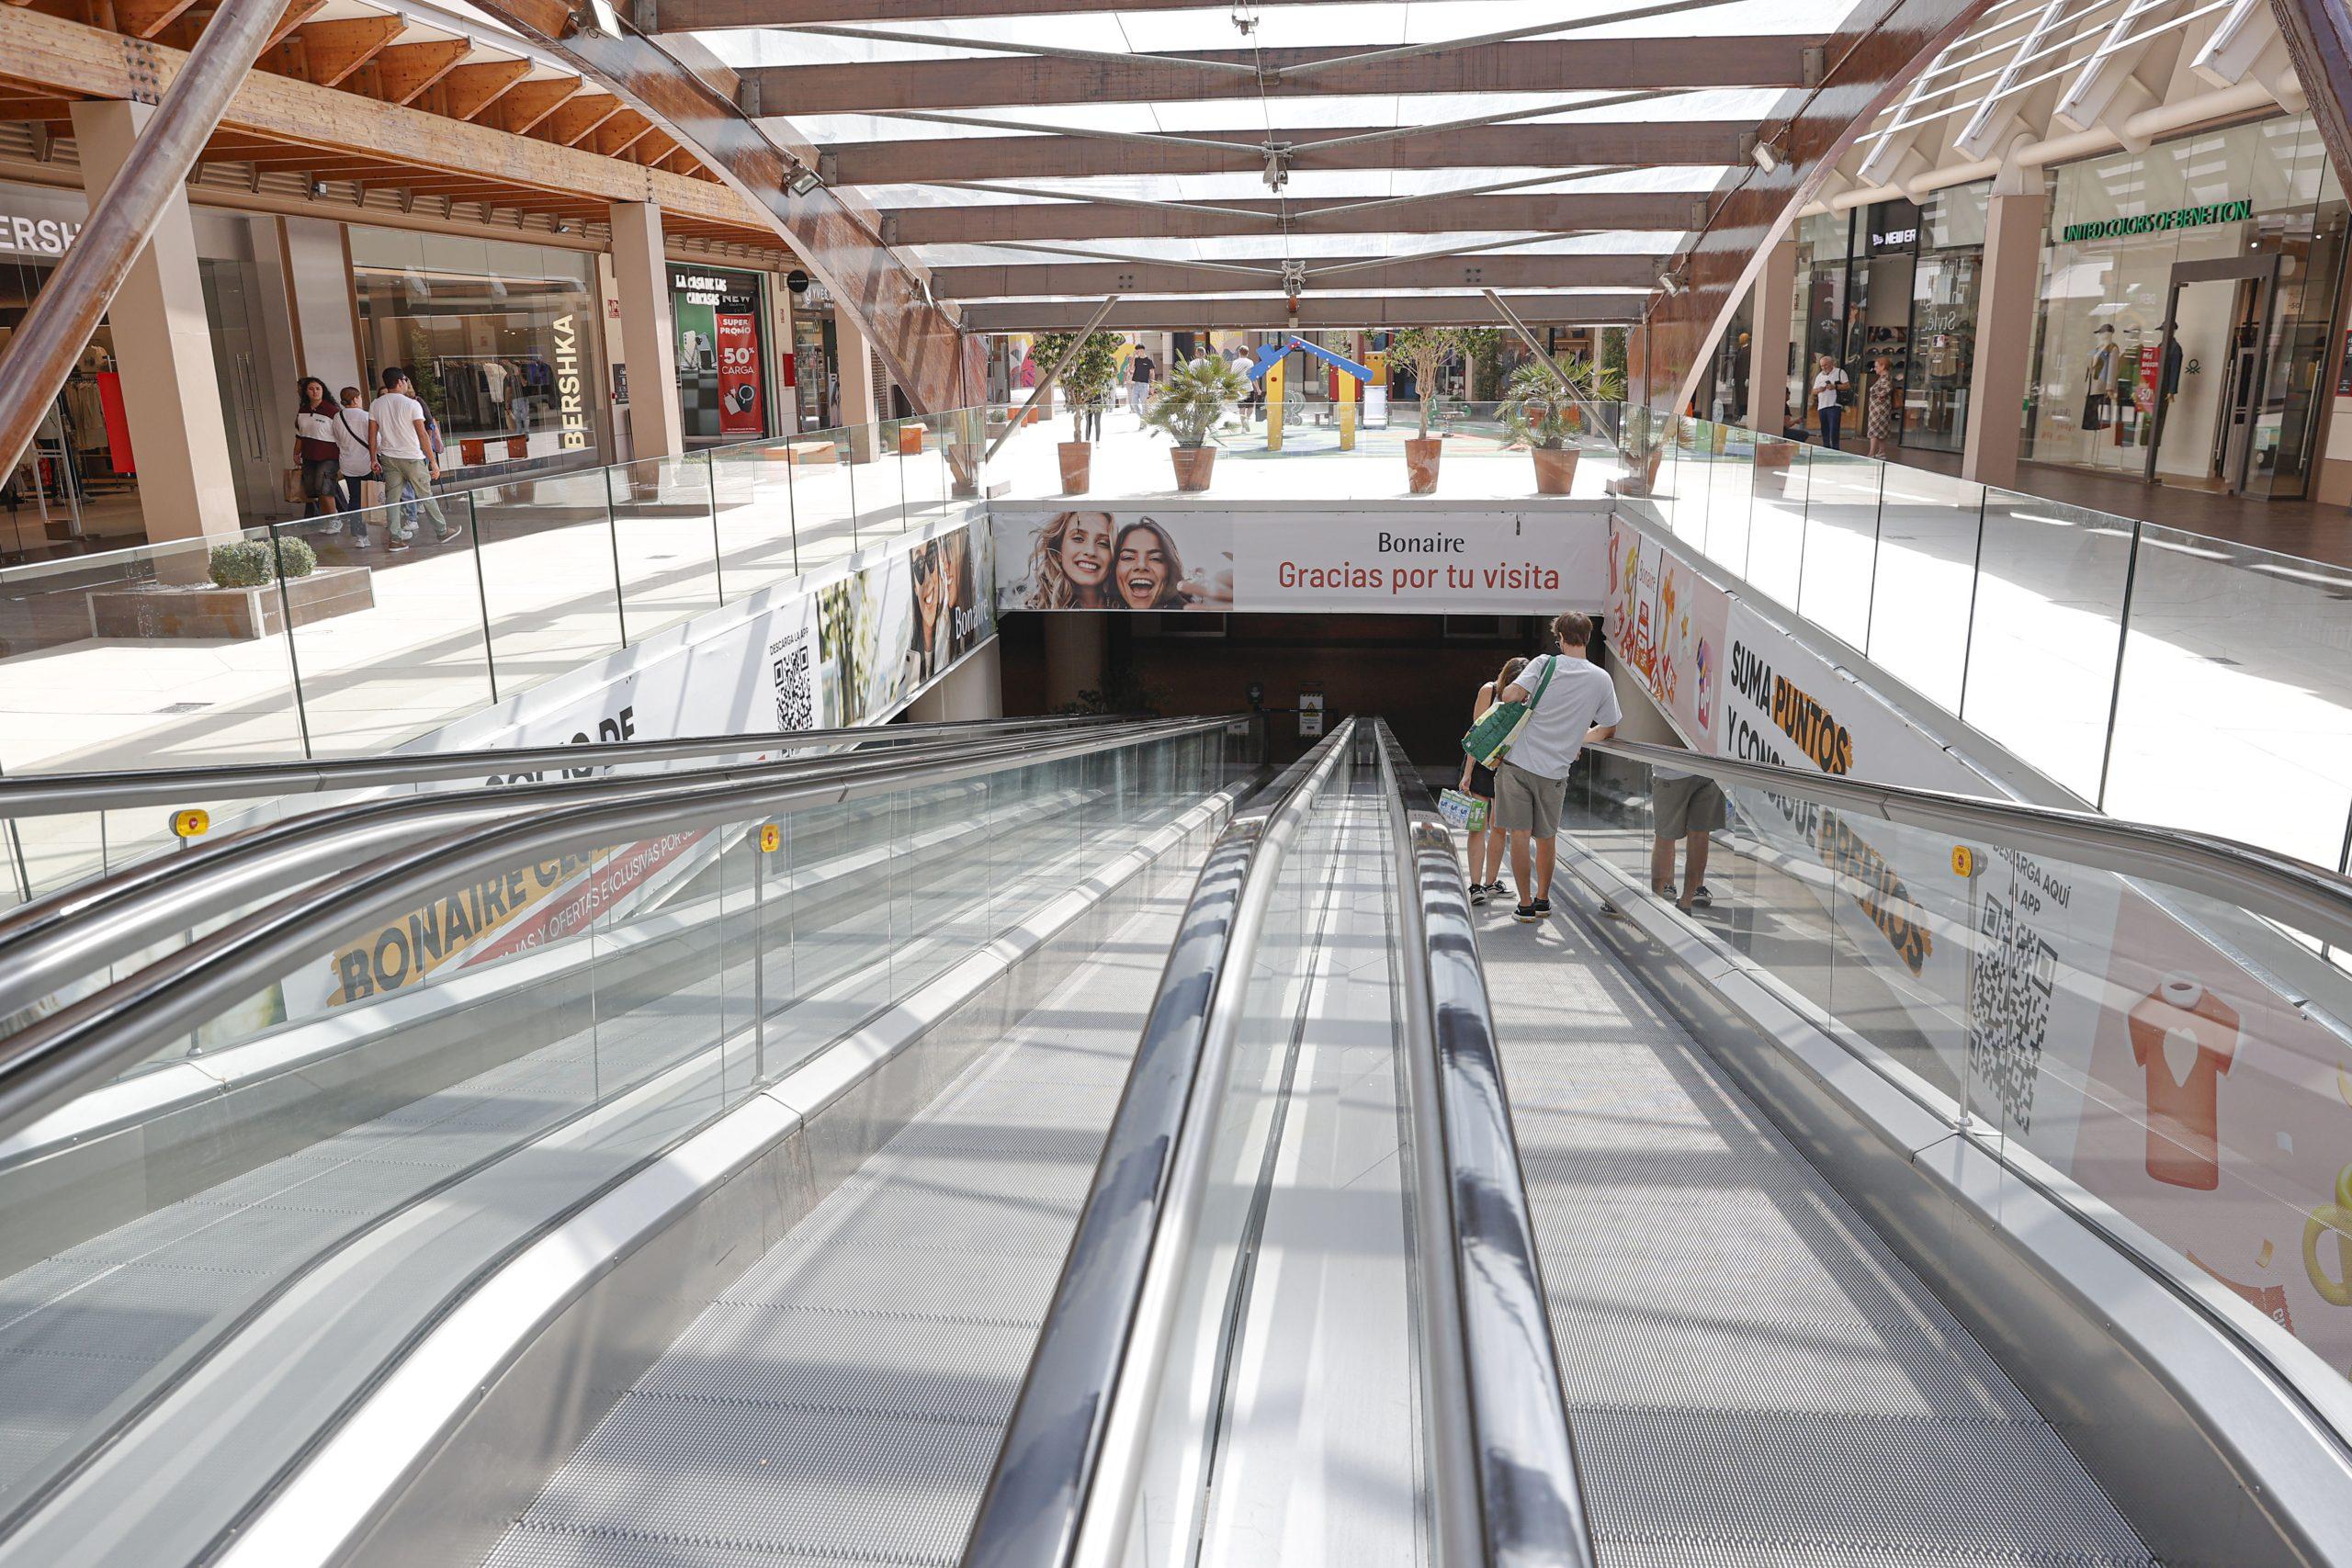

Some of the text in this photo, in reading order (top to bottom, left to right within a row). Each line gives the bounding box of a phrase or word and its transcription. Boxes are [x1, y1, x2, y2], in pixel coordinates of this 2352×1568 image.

[1885, 229, 1917, 245] NEW ER
[2063, 221, 2104, 243] UNITED
[2105, 213, 2154, 237] COLORS
[2154, 210, 2177, 231] OF
[675, 274, 727, 292] LA CASA DE LAS
[686, 292, 720, 306] CARCASAS
[722, 318, 749, 326] SUPER
[719, 346, 754, 365] -50%
[721, 366, 754, 375] CARGA
[552, 314, 585, 449] BERSHKA
[1378, 532, 1464, 553] Bonaire
[1279, 561, 1559, 595] Gracias por tu visita
[956, 598, 989, 640] Bonaire
[1731, 640, 1771, 717] SUMA
[1773, 674, 1849, 775] PUNTOS
[1728, 705, 1737, 752] Y
[601, 843, 660, 899] EXCLUSIVAS
[2020, 889, 2041, 917] APP
[2042, 874, 2072, 909] AQUÍ
[537, 924, 547, 945] Y
[550, 887, 600, 938] OFERTAS
[338, 867, 528, 1004] BONAIRE
